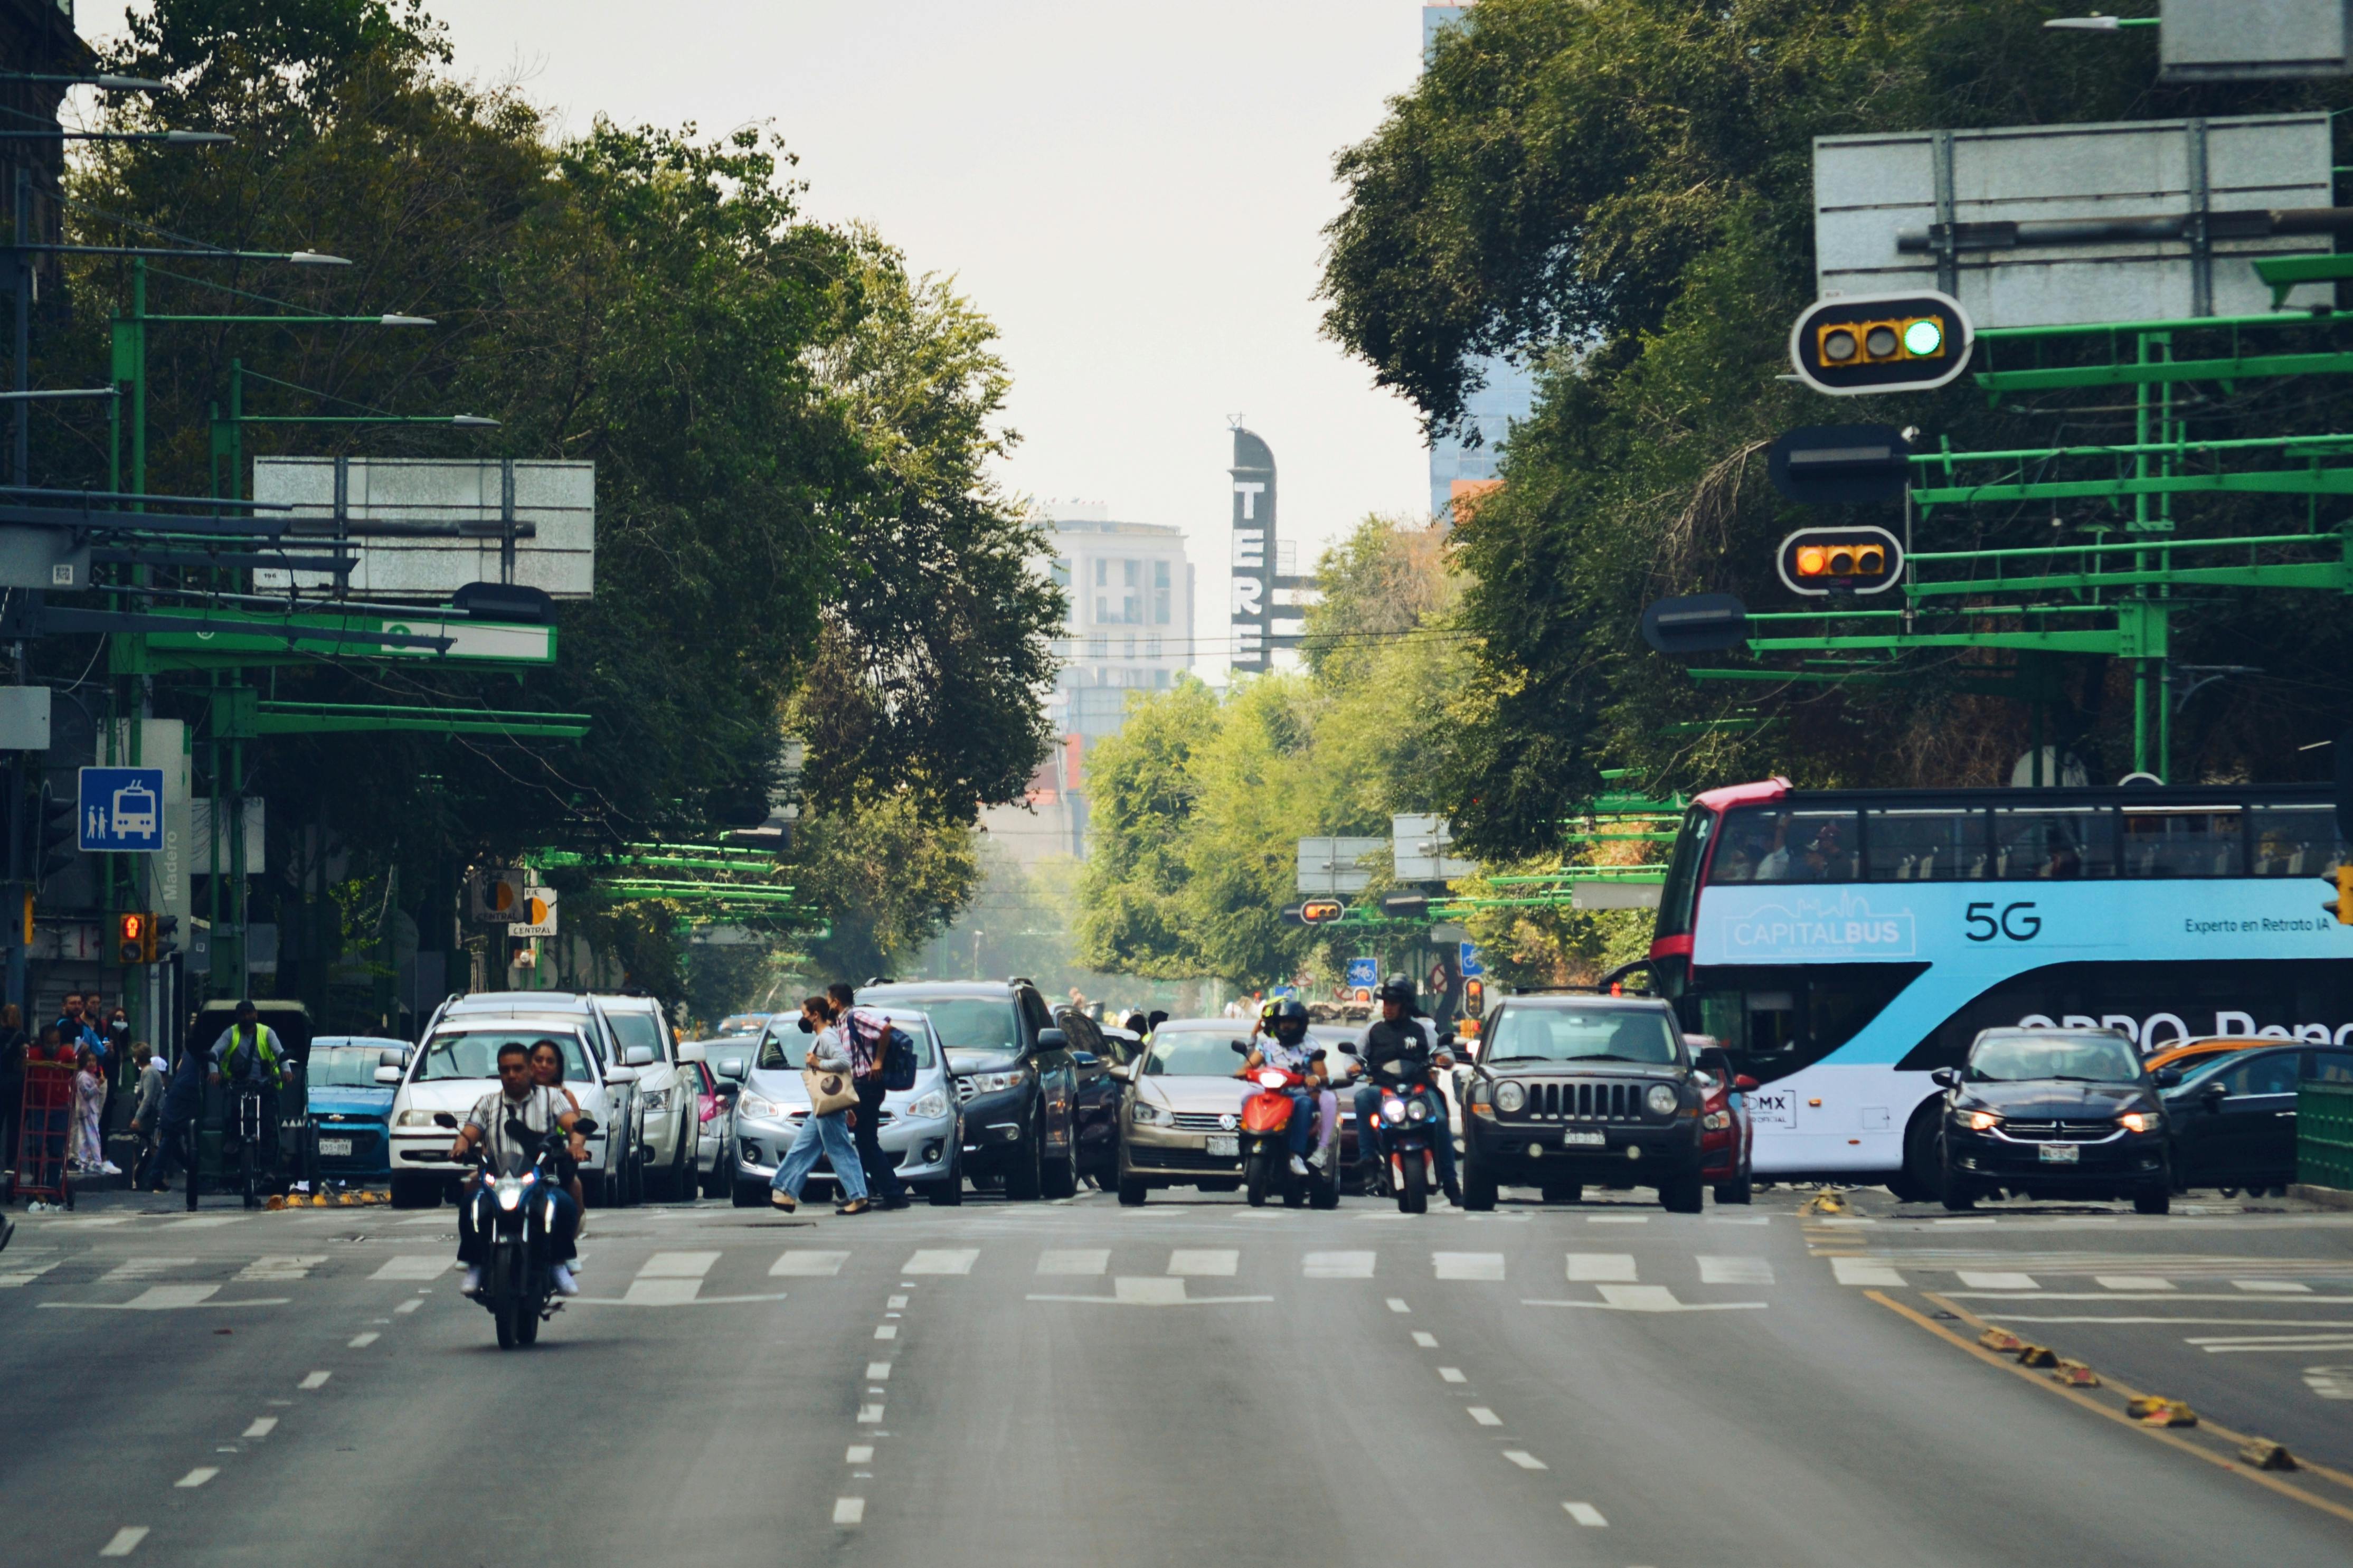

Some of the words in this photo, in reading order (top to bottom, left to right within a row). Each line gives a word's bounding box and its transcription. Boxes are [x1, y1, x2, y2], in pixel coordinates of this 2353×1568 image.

[164, 830, 177, 900] Madero
[1734, 921, 1900, 946] CAPITALBUS
[1965, 902, 2042, 942] 5G
[2185, 919, 2238, 935] Experto
[2242, 920, 2259, 932] en
[2263, 918, 2313, 931] Retrato
[2317, 918, 2330, 930] IA
